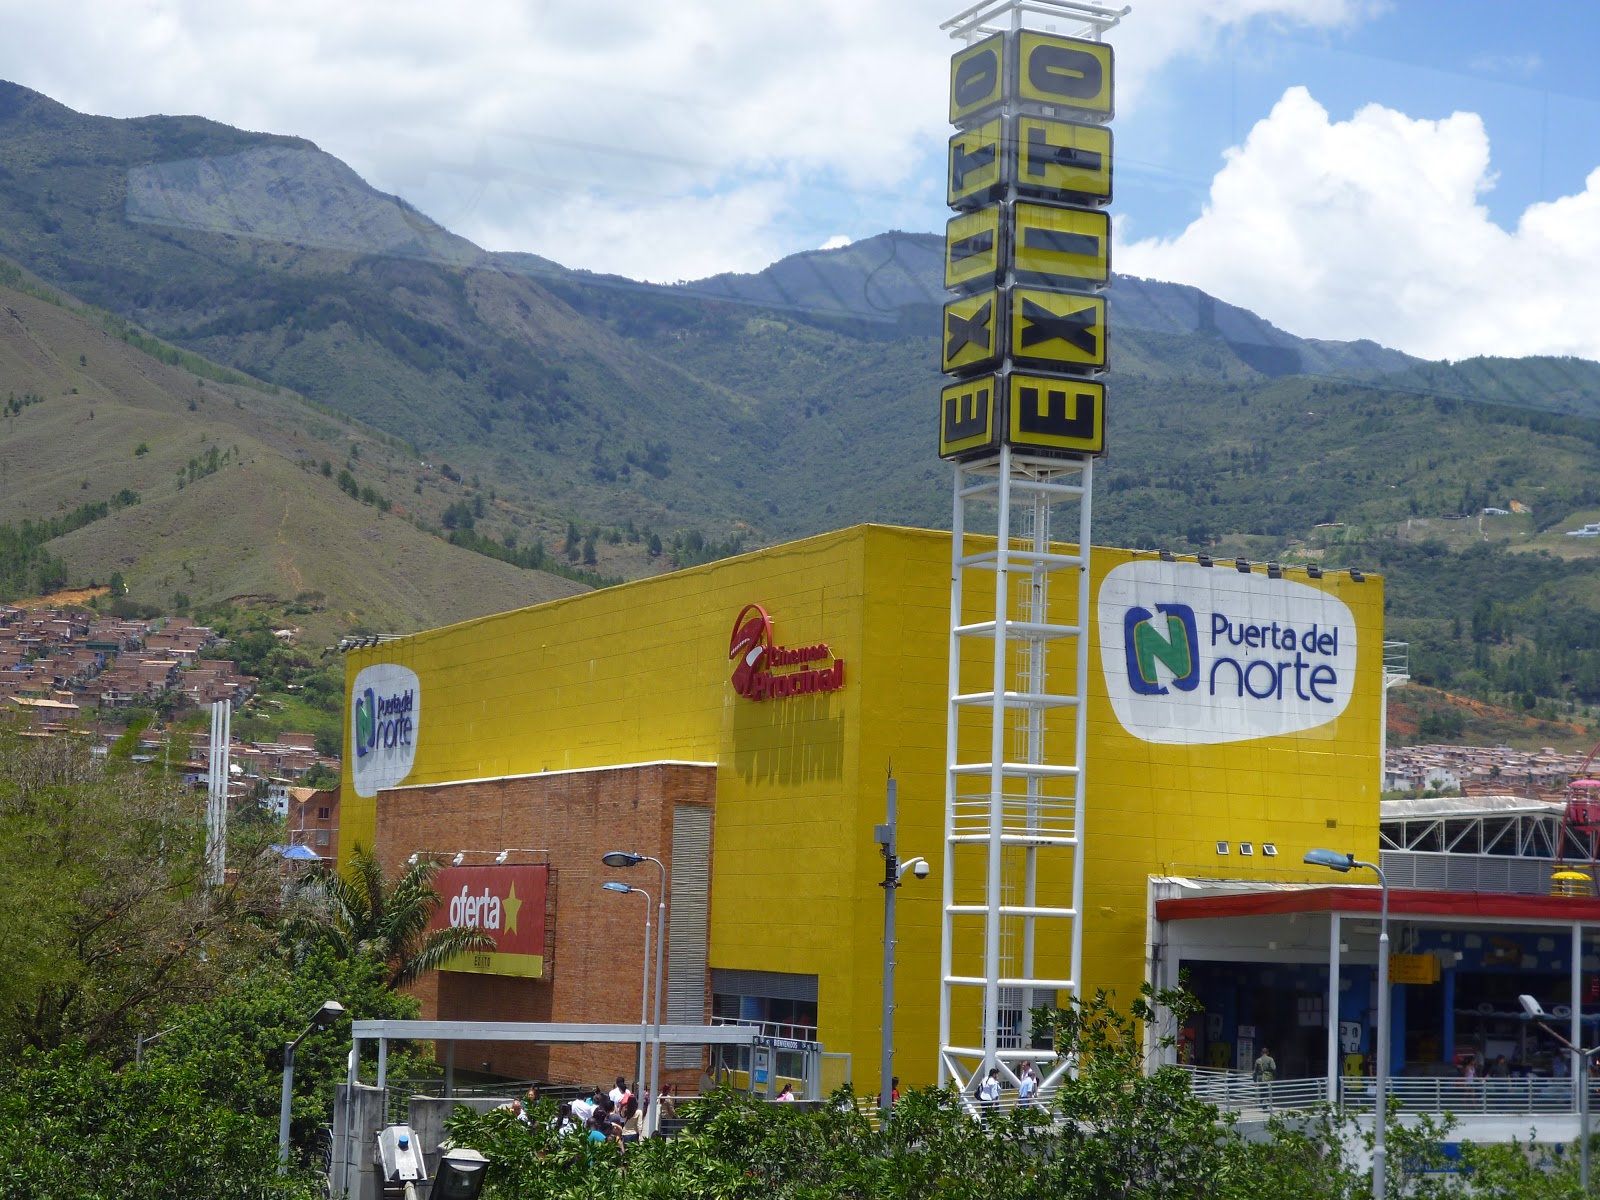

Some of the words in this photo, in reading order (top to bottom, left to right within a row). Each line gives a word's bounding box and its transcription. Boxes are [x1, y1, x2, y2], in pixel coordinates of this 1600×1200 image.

[1019, 44, 1104, 439] EXITO
[1211, 613, 1297, 650] Puerta
[1302, 624, 1338, 656] del
[752, 659, 844, 702] Procinal
[1210, 652, 1337, 703] norte
[377, 693, 401, 720] Puerta
[401, 689, 413, 712] del
[376, 712, 413, 750] norte
[450, 885, 500, 929] oferta
